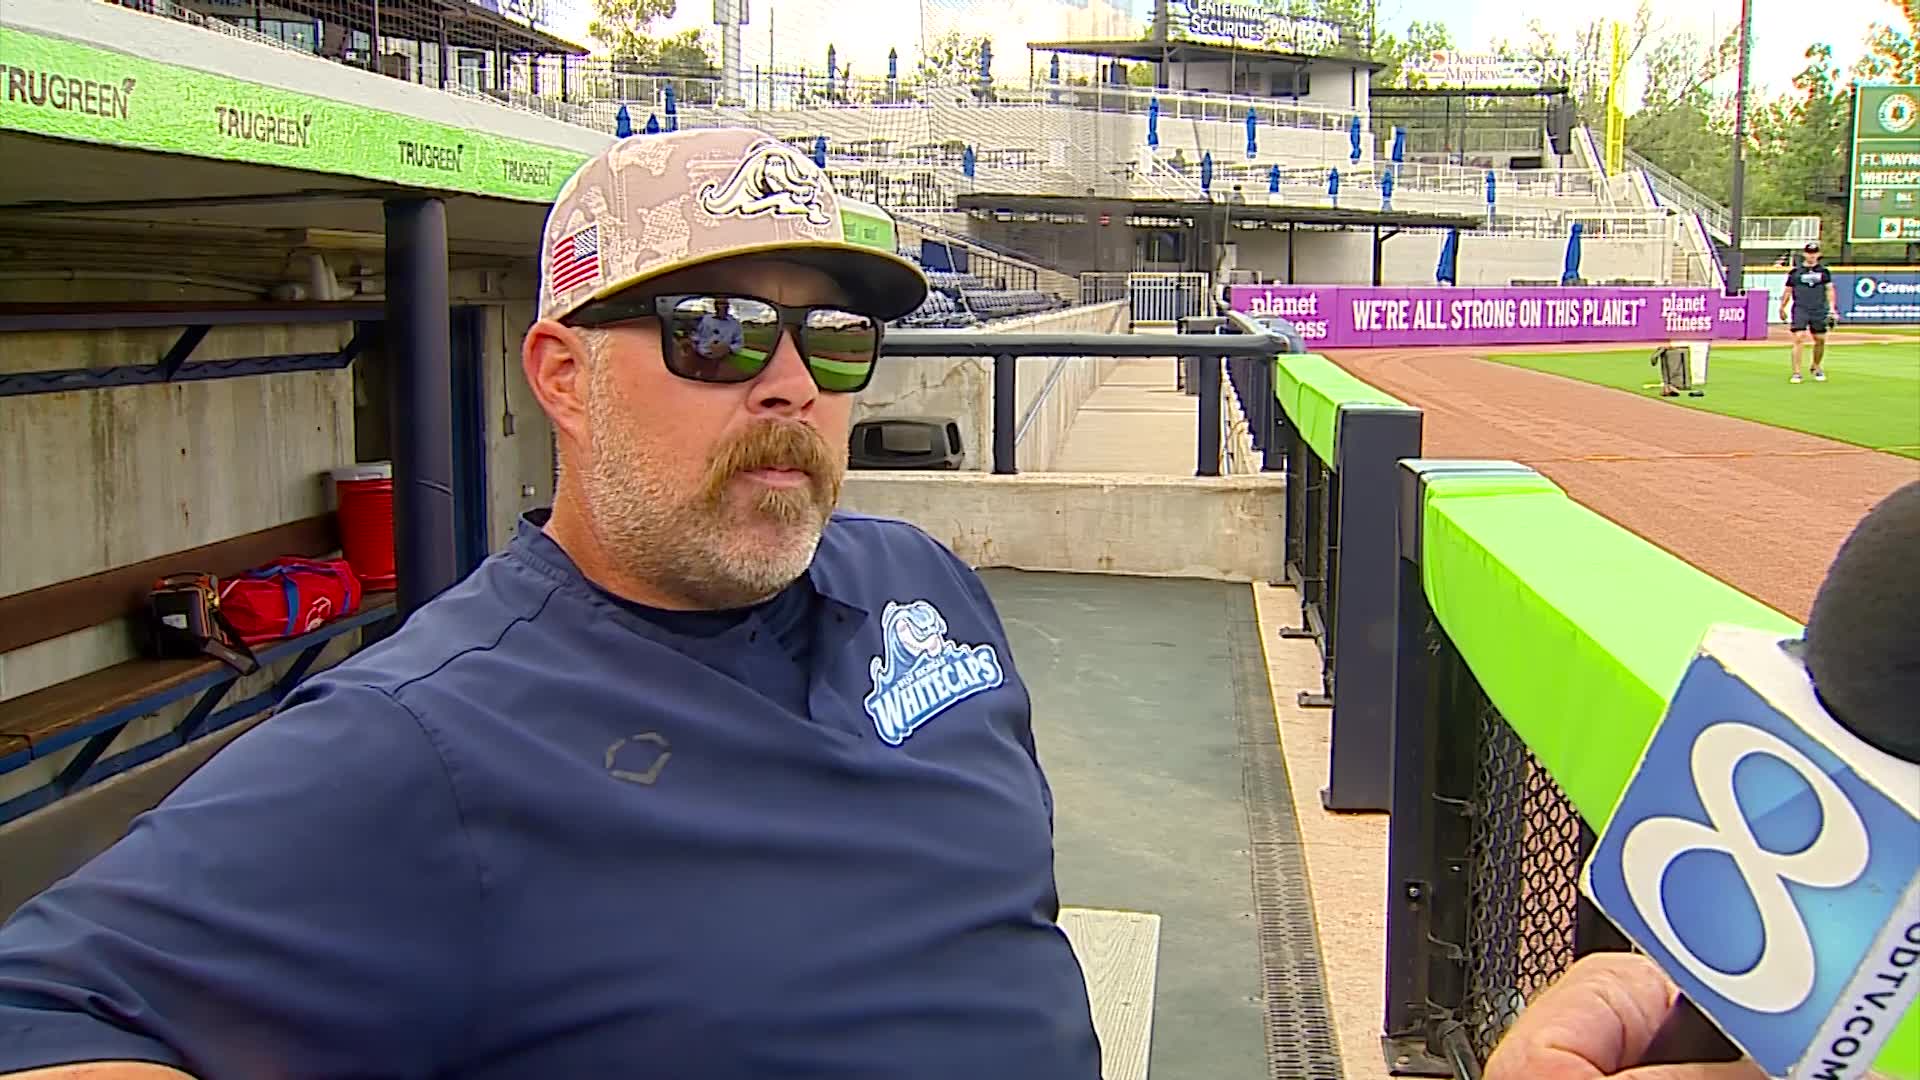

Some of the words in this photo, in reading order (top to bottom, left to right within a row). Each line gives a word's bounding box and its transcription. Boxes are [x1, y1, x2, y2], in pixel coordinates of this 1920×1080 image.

[1187, 0, 1265, 20] CENTENNIAL
[1191, 13, 1265, 41] SECURITIES
[1447, 52, 1498, 65] Doeren
[1446, 67, 1502, 83] Mayhew
[215, 106, 309, 148] TRUGREEN
[399, 140, 463, 173] TRUGREEN
[502, 159, 552, 186] TRUGREEN
[1353, 300, 1410, 331] WE'RE
[1413, 299, 1448, 331] ALL
[1450, 298, 1516, 330] STRONG
[1519, 298, 1542, 328] ON
[1545, 297, 1580, 328] THIS
[1661, 292, 1706, 318] planet
[1718, 307, 1746, 322] PATIO
[1666, 312, 1713, 332] fitness
[870, 650, 995, 738] WHITECAPS
[1622, 721, 1871, 1014] 8
